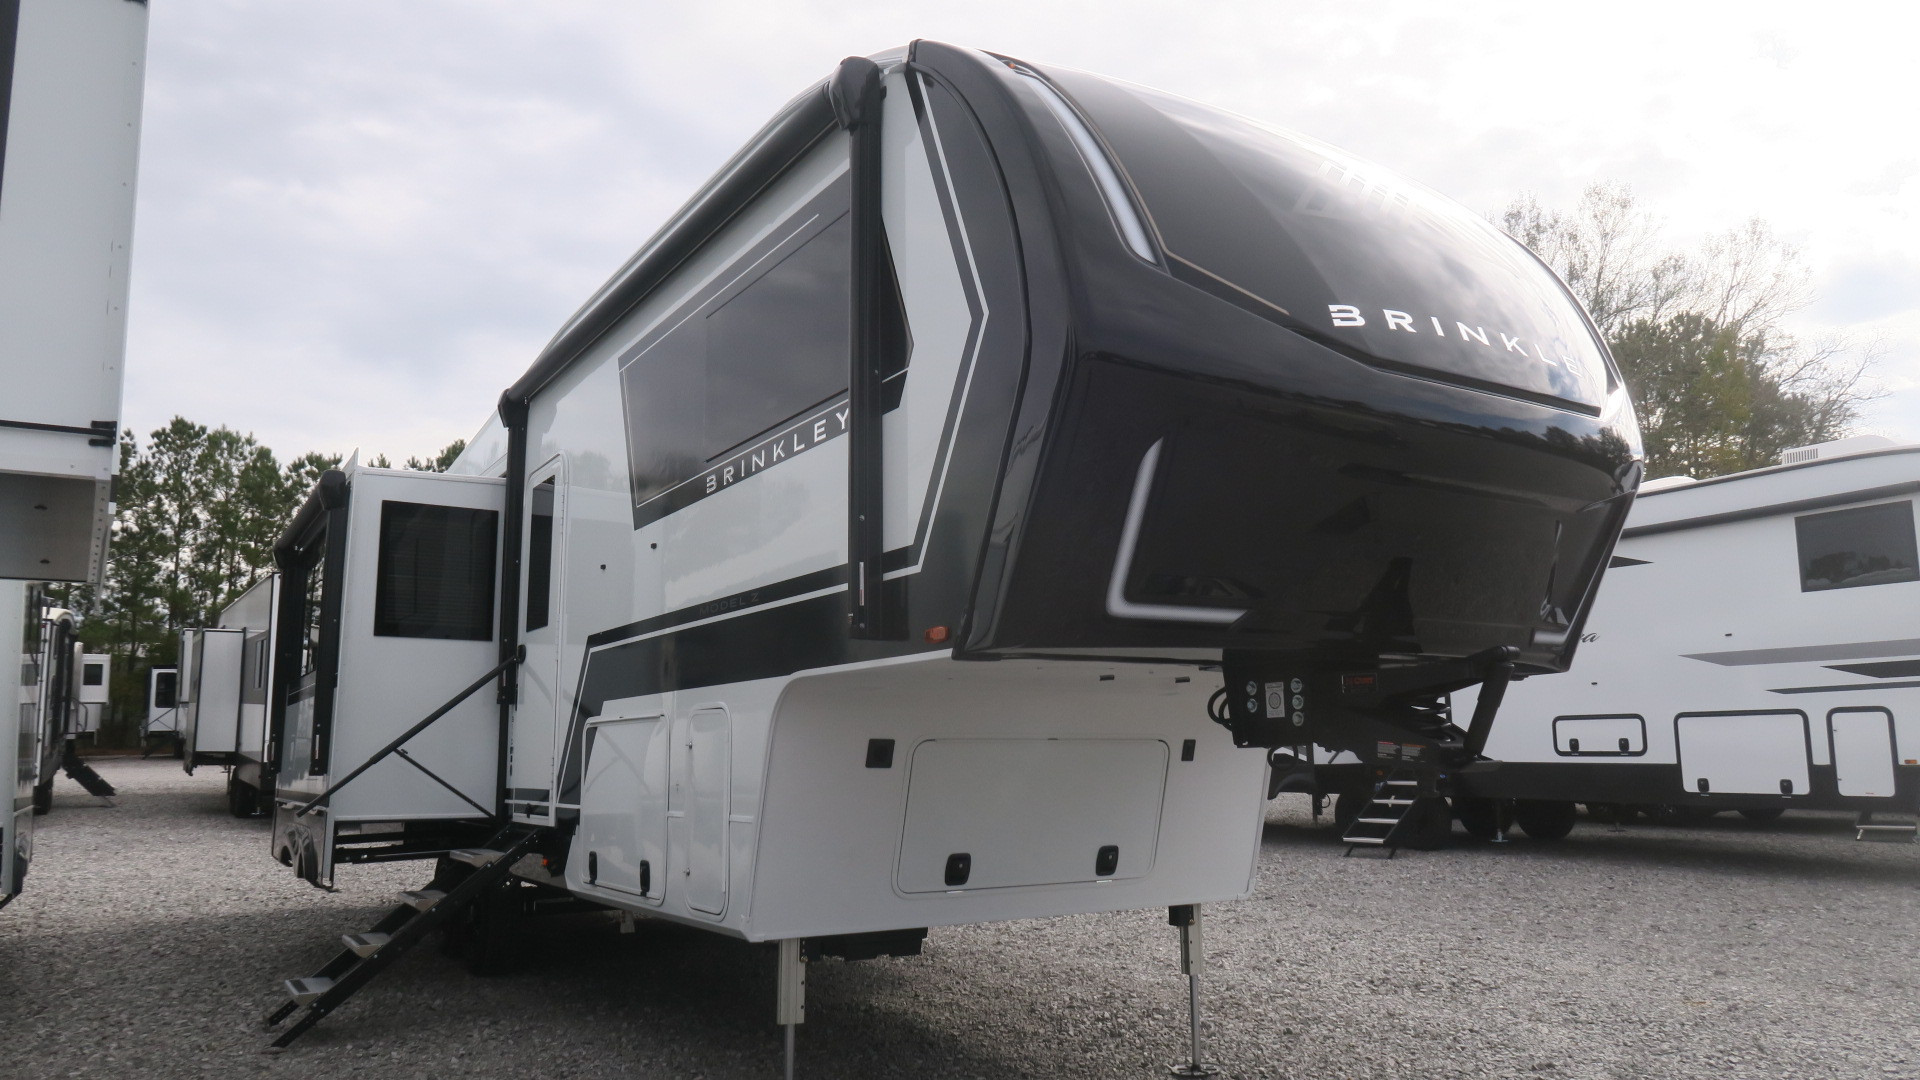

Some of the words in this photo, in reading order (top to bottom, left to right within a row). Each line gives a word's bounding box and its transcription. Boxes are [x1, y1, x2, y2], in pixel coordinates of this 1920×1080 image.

[1328, 304, 1583, 377] BRINKLE
[706, 408, 849, 493] BRINKLEY
[700, 597, 746, 615] MODEL
